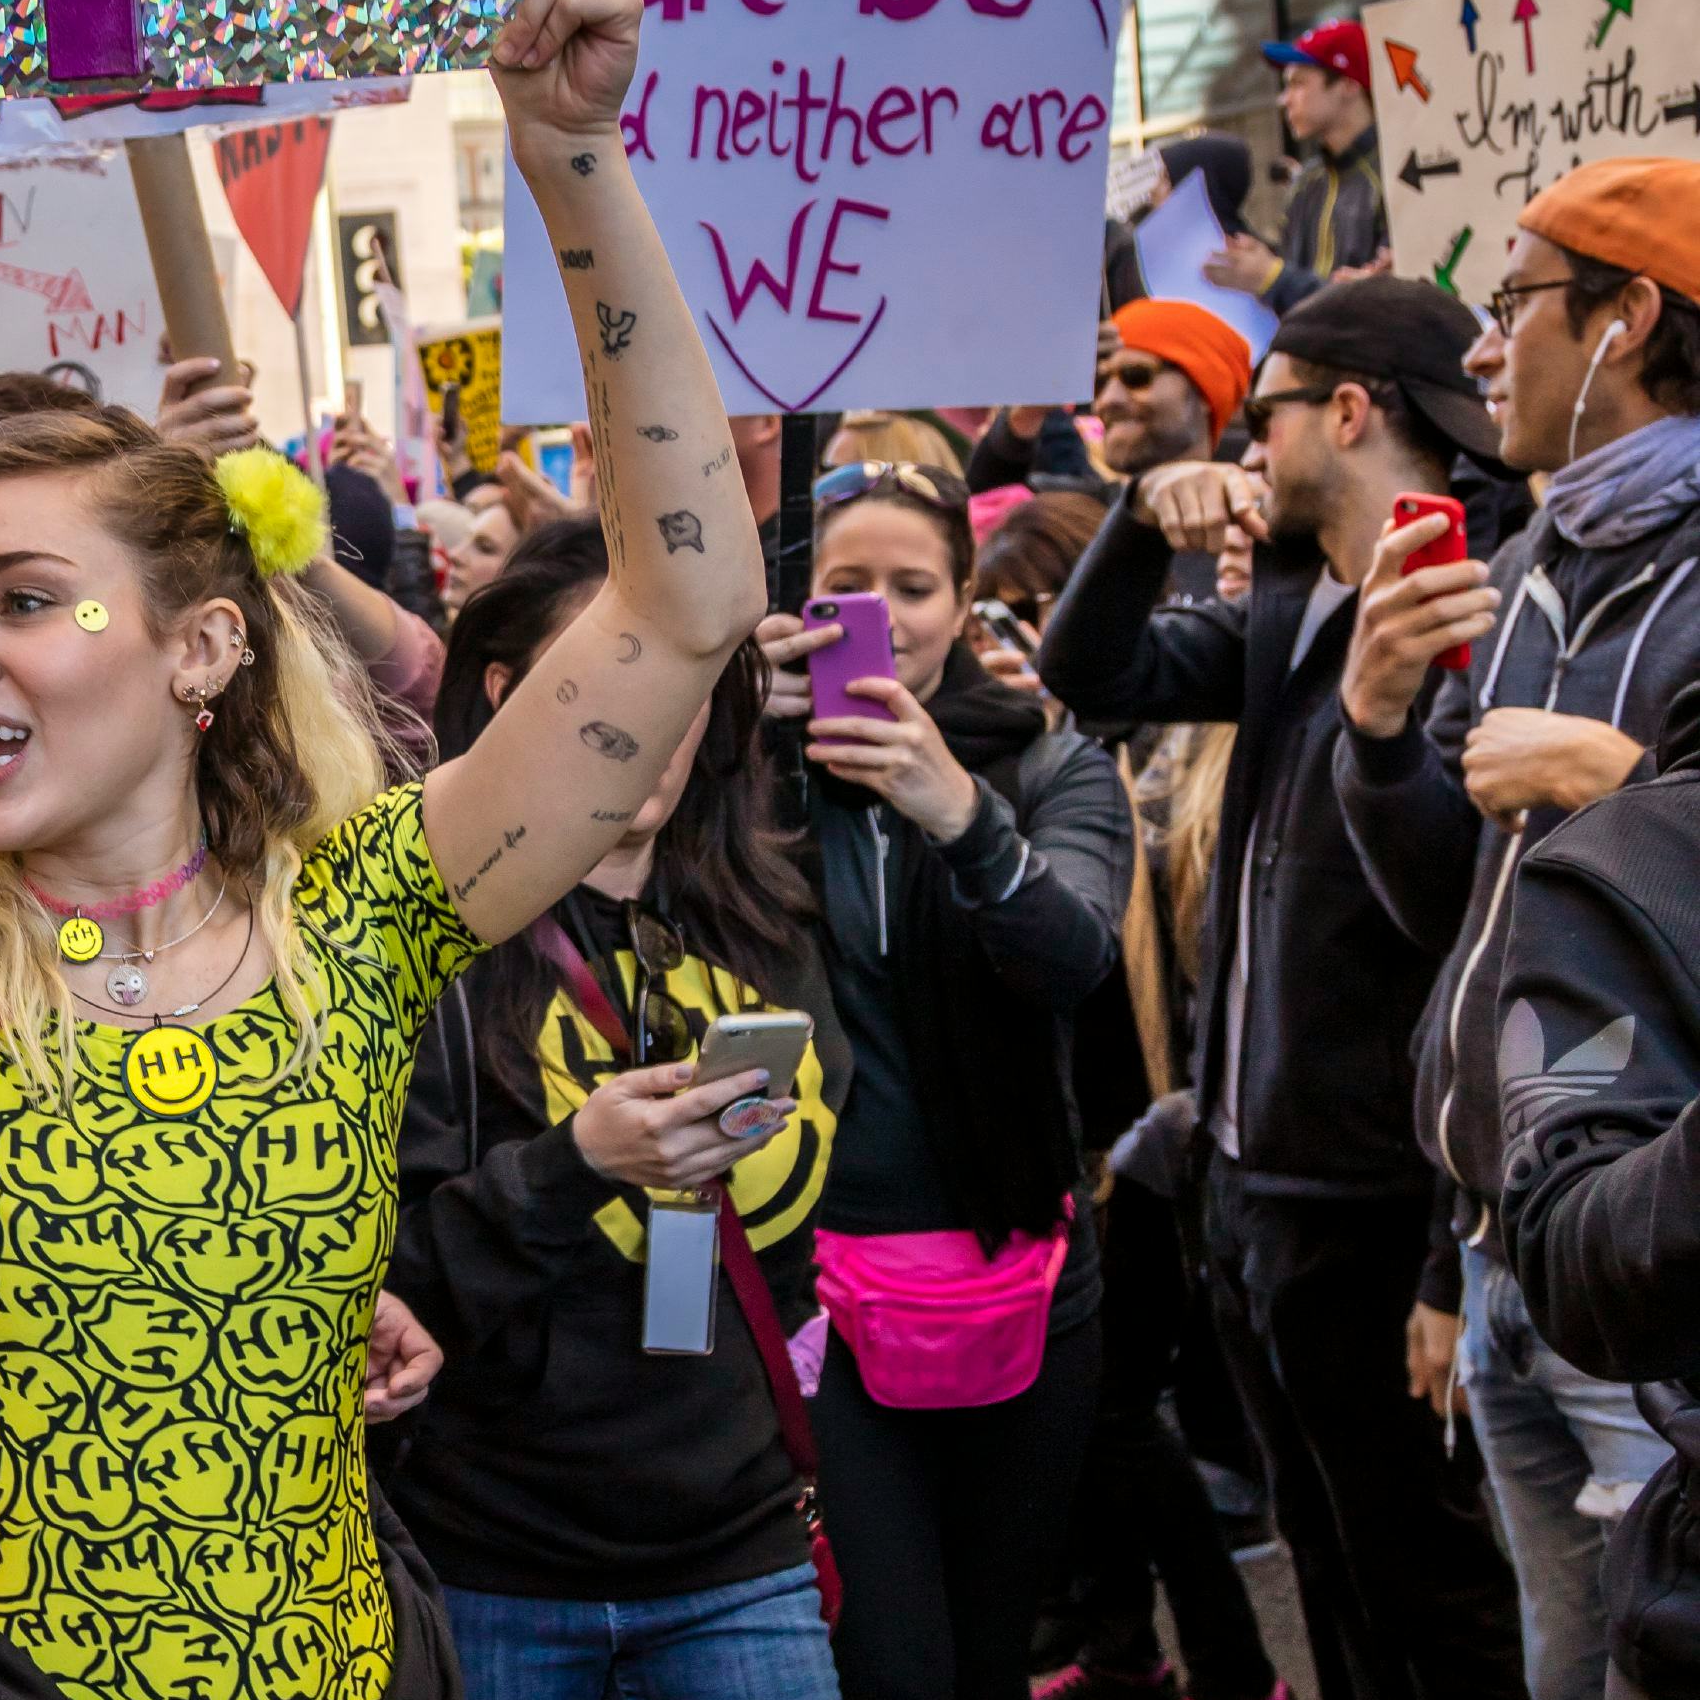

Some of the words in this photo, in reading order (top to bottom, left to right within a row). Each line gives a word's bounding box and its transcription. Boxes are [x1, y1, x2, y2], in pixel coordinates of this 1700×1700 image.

[689, 54, 960, 183] neither
[980, 86, 1108, 163] are
[1550, 45, 1660, 136] with
[700, 197, 892, 325] WE
[48, 300, 147, 358] MAN
